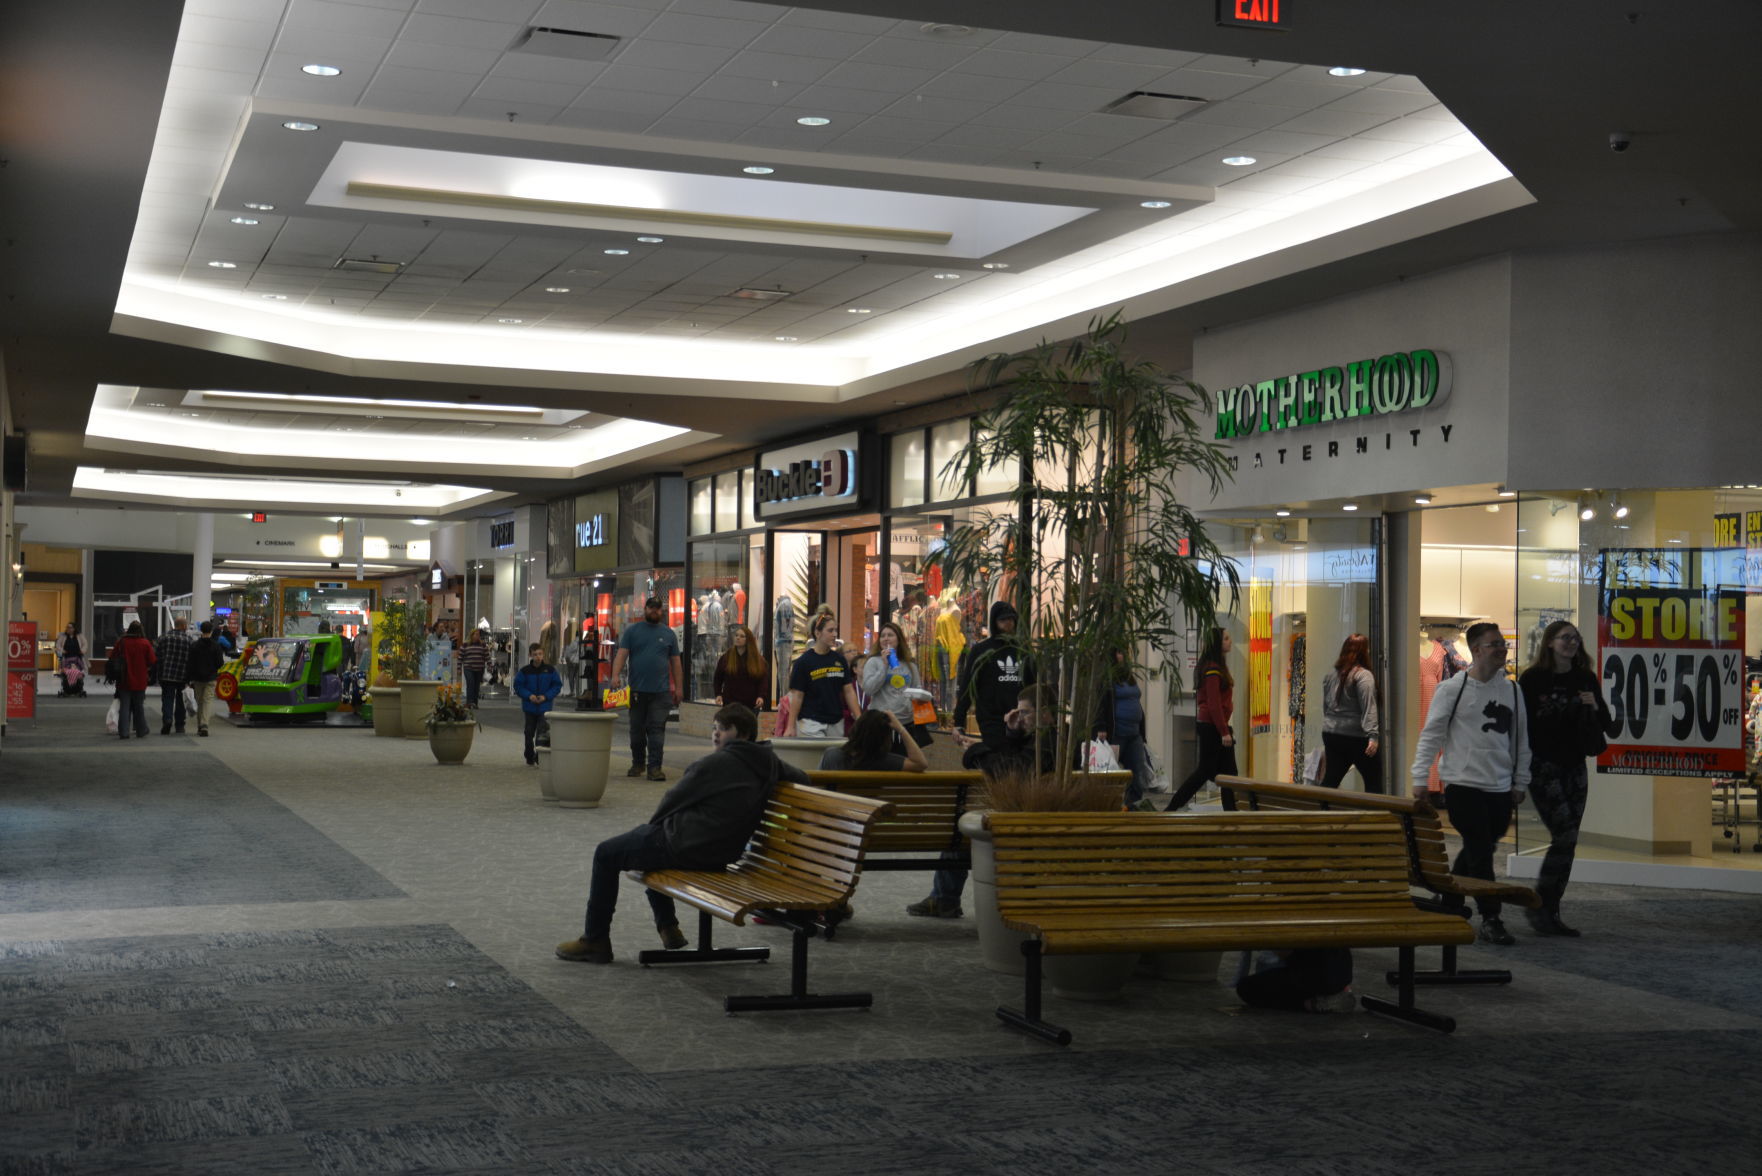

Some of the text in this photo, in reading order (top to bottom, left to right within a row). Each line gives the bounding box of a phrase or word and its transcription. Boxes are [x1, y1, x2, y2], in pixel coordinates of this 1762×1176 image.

[1235, 0, 1279, 23] EXIT
[1215, 349, 1440, 440] MOTHERHOOD
[1228, 425, 1453, 472] MATERNITY
[756, 460, 820, 503] Buckle
[576, 514, 604, 548] rue 21
[1610, 596, 1738, 641] STORE
[1723, 708, 1739, 725] OFF
[1645, 768, 1702, 777] EXCEPTIONS
